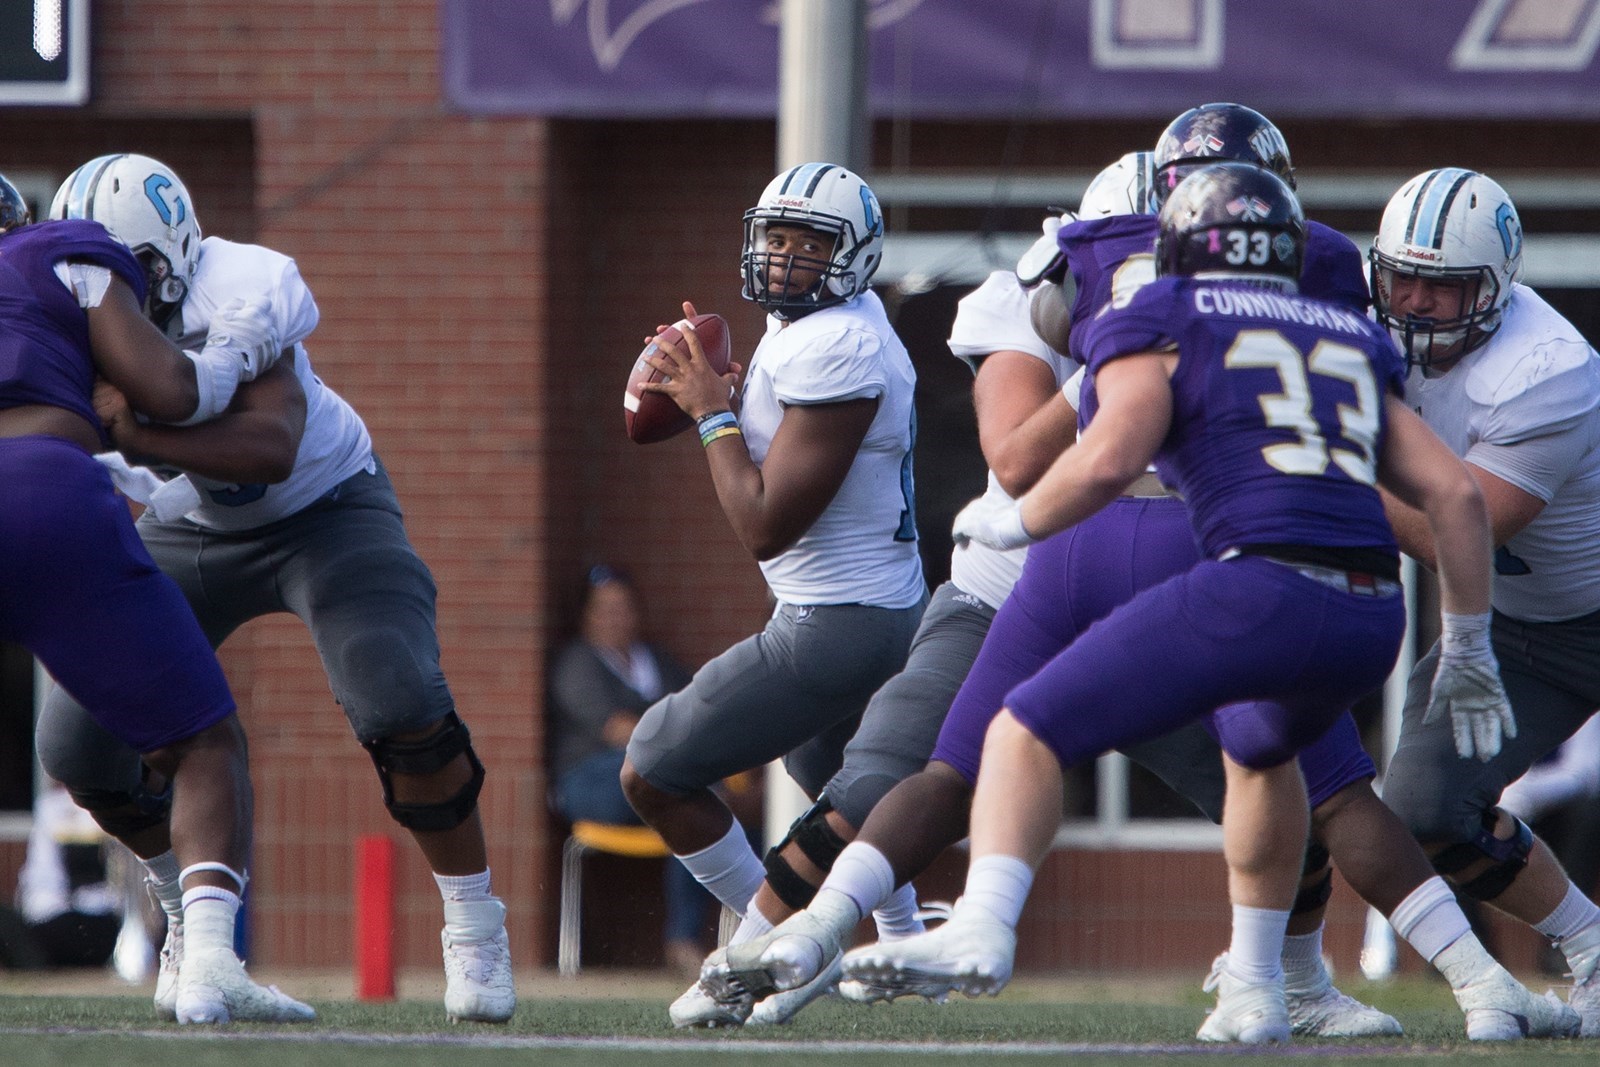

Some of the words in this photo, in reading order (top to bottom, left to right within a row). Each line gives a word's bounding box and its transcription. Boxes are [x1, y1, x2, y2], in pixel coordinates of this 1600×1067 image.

[778, 198, 804, 208] Riddell
[1225, 230, 1271, 266] 33
[1406, 248, 1435, 262] Riddell
[1195, 287, 1373, 337] CUNNINGHAM
[1224, 329, 1380, 485] 33
